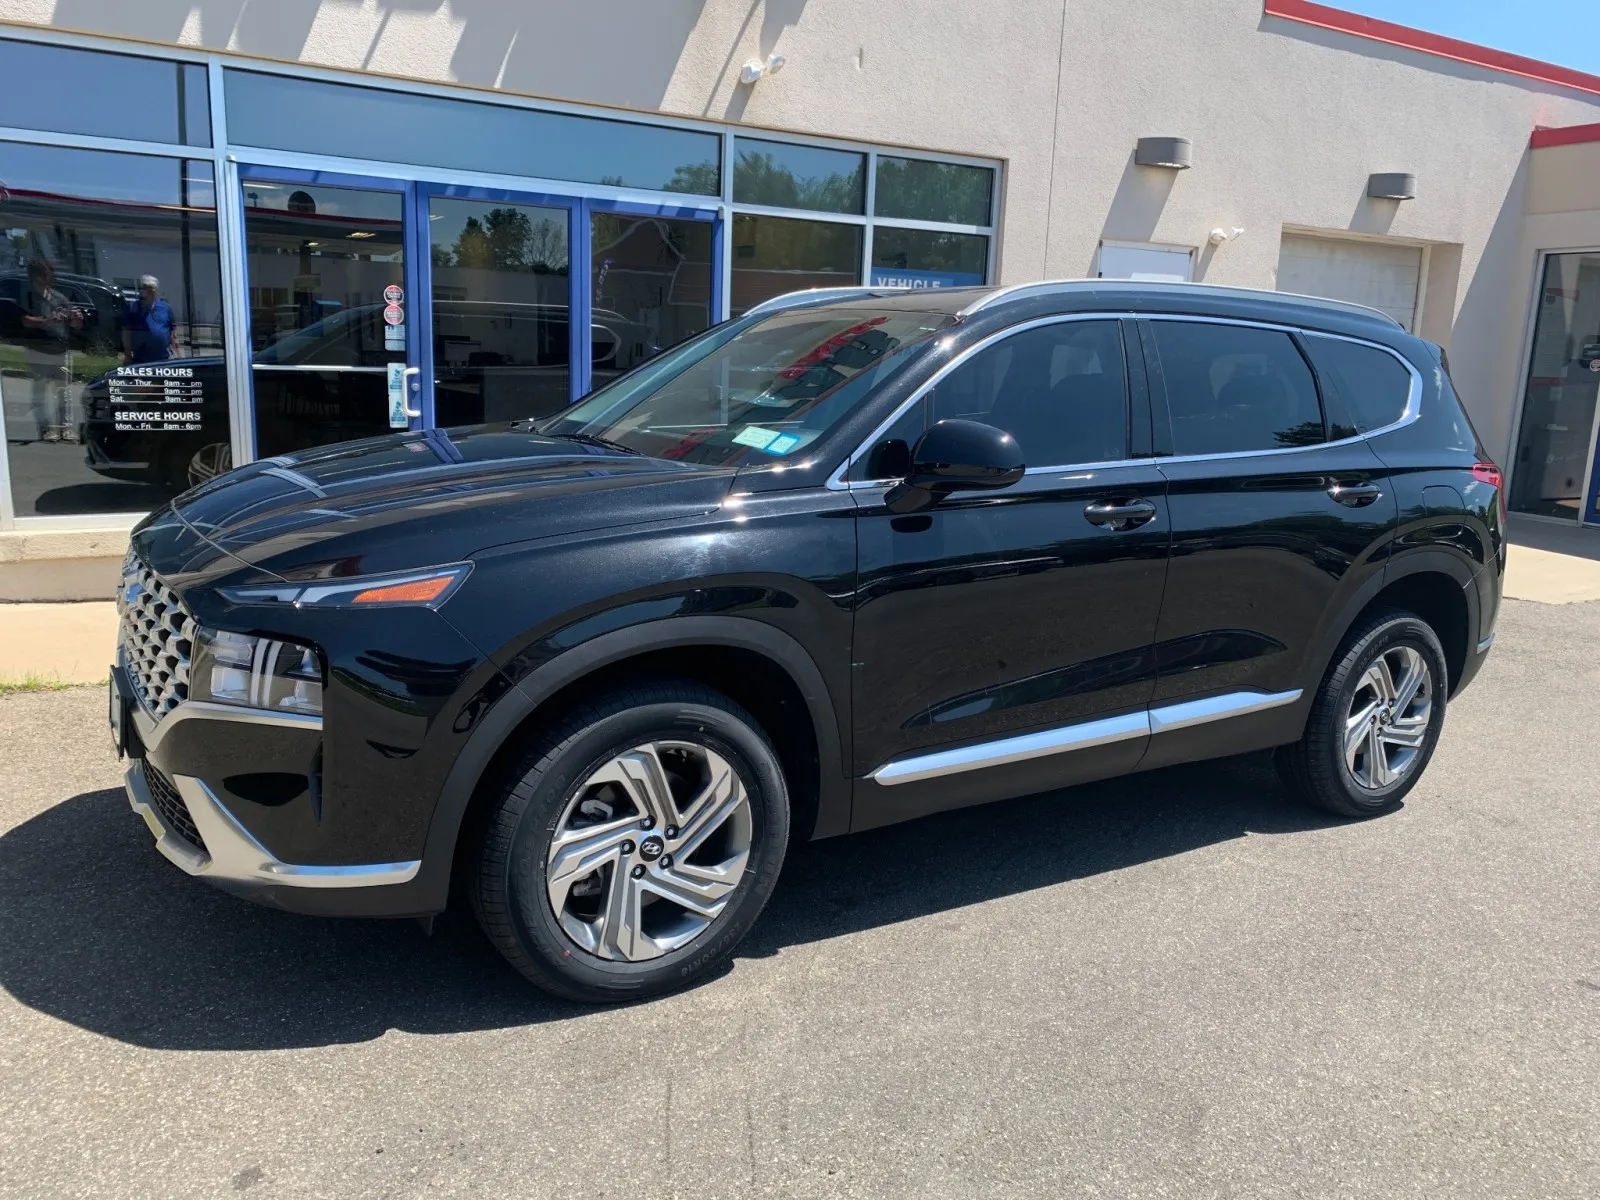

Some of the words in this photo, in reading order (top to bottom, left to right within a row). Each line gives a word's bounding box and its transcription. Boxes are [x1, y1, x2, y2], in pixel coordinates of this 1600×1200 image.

[878, 277, 941, 289] VEHICLE
[117, 367, 153, 376] SALES
[156, 368, 193, 377] HOURS
[115, 412, 161, 421] SERVICE
[163, 412, 201, 421] HOURS
[185, 423, 202, 431] 6pm
